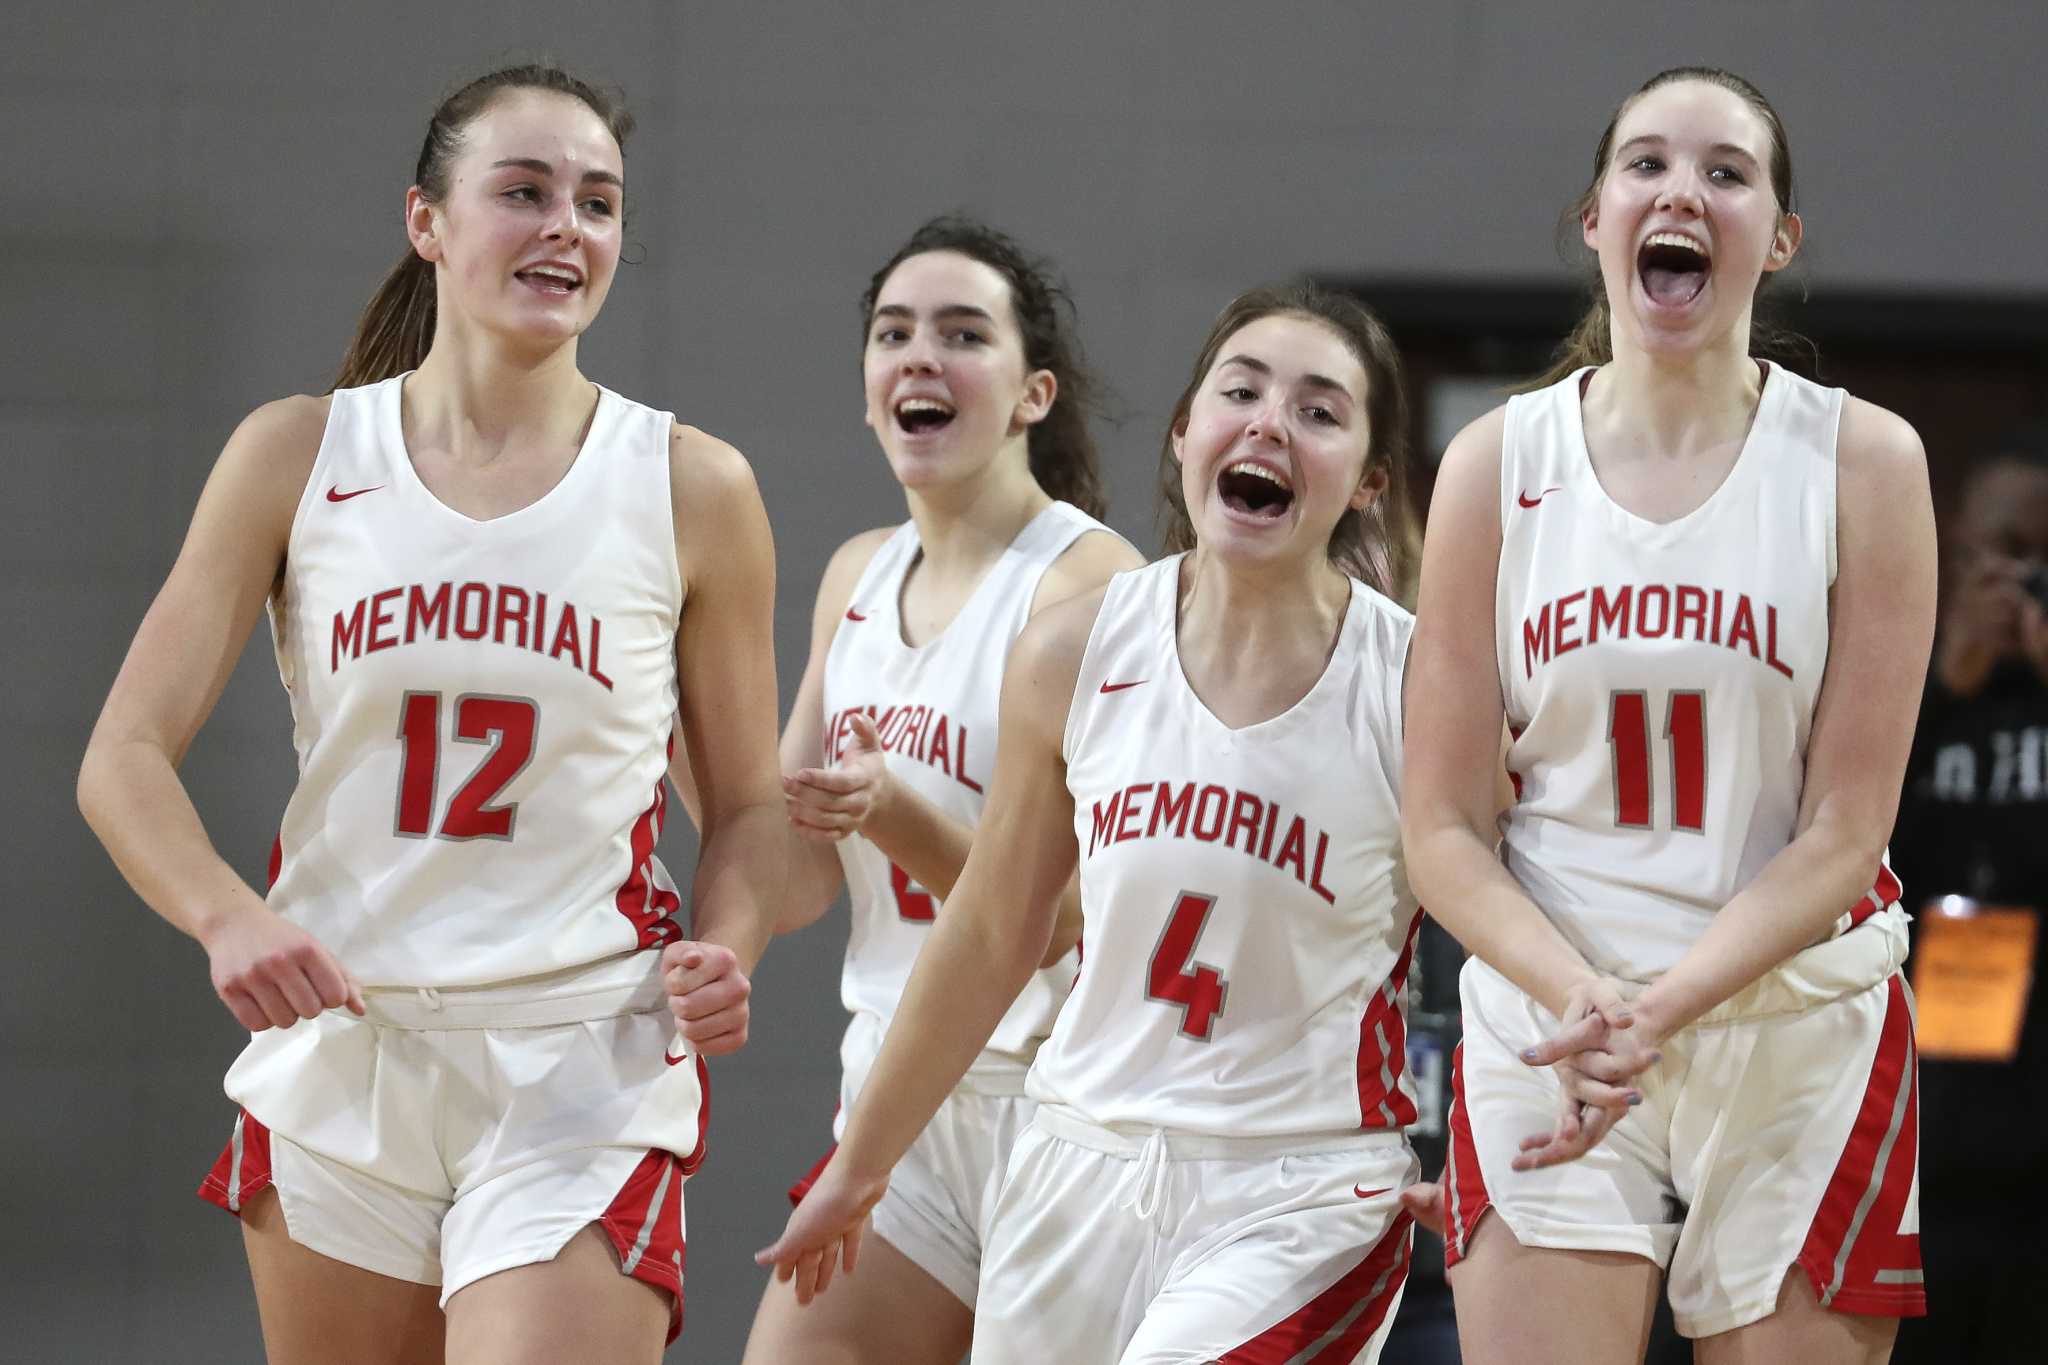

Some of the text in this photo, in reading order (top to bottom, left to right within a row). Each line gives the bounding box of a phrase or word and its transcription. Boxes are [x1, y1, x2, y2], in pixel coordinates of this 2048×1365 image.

[331, 581, 614, 693] MEMORIAL
[1523, 584, 1794, 681] MEMORIAL
[393, 690, 541, 842] 12
[1606, 689, 1709, 836] 11
[1088, 781, 1336, 906] MEMORIAL
[1144, 889, 1229, 1043] 4
